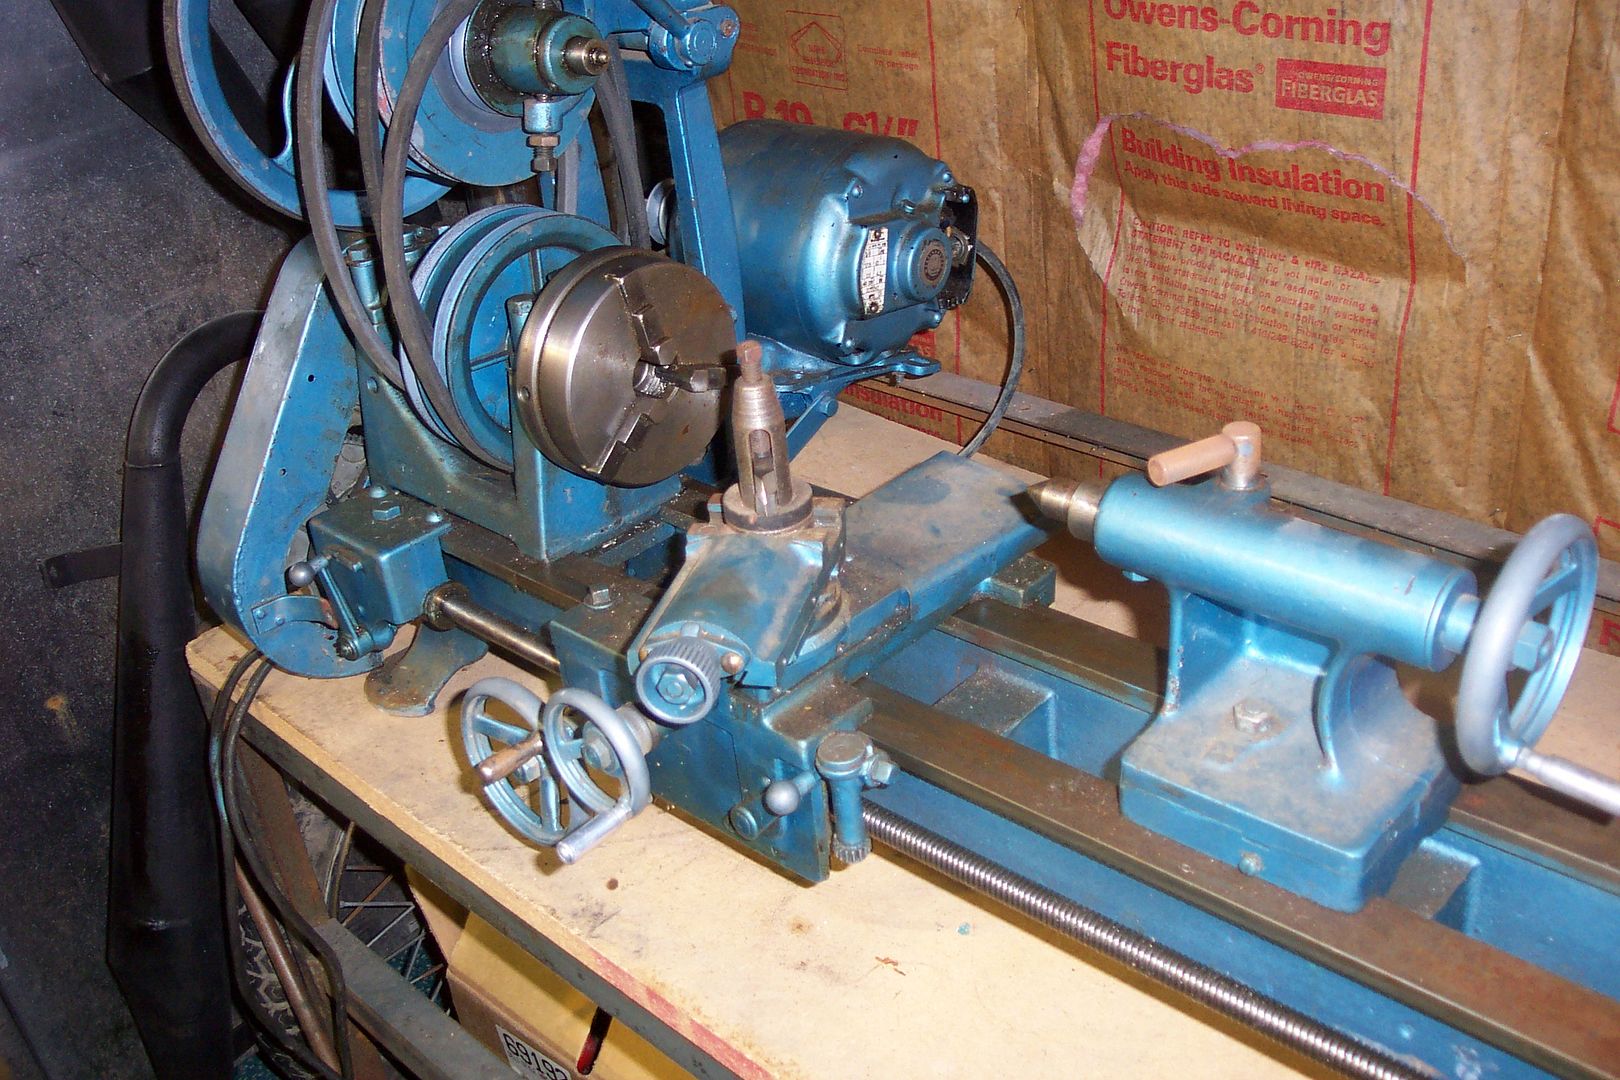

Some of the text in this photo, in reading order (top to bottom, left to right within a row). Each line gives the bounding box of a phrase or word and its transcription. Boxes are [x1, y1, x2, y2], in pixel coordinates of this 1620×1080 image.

[1103, 0, 1391, 57] Owens-Corning
[1281, 79, 1378, 107] FIBERGLAS
[1121, 128, 1385, 202] Building Insulation
[1124, 160, 1385, 226] Apply this side toward living space.
[1131, 229, 1186, 250] STATEMENT
[1190, 244, 1204, 255] ON
[1183, 229, 1213, 244] REFER
[1217, 237, 1230, 248] TO
